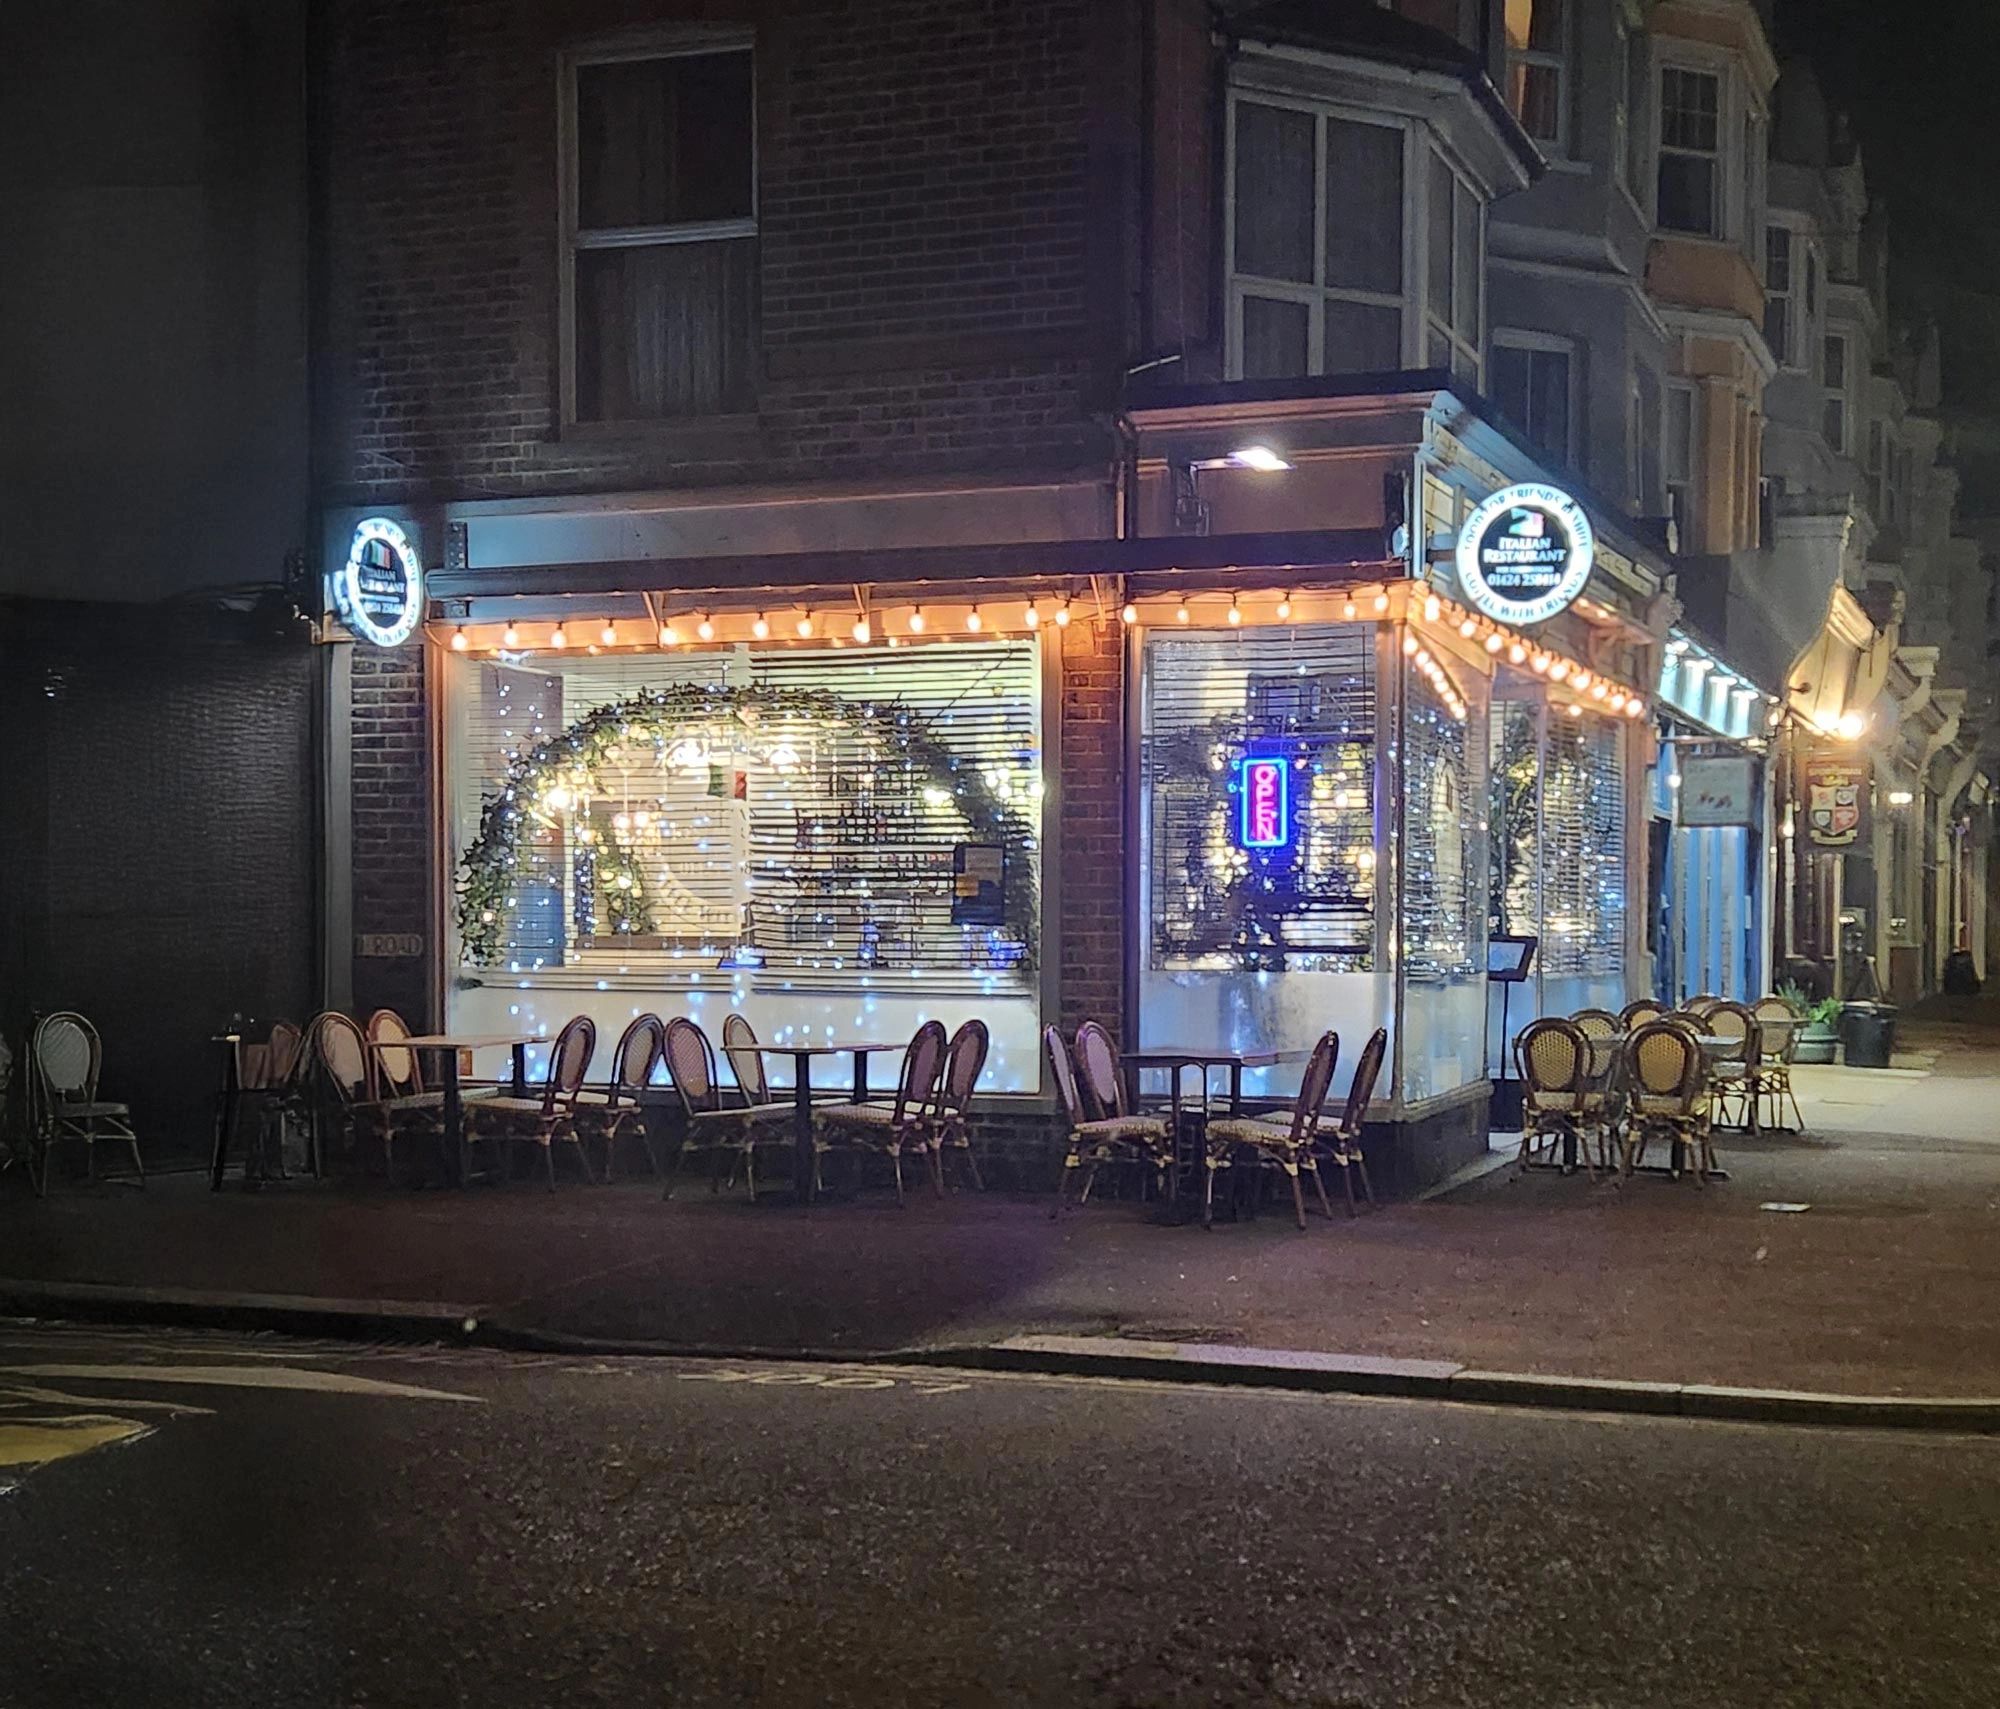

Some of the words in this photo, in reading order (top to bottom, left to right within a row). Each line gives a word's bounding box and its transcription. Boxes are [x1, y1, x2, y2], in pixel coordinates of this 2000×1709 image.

[1499, 537, 1552, 550] ITALIAN
[1483, 548, 1567, 564] RESTAURANT
[1487, 573, 1520, 587] 01424
[1255, 765, 1277, 841] OPEN
